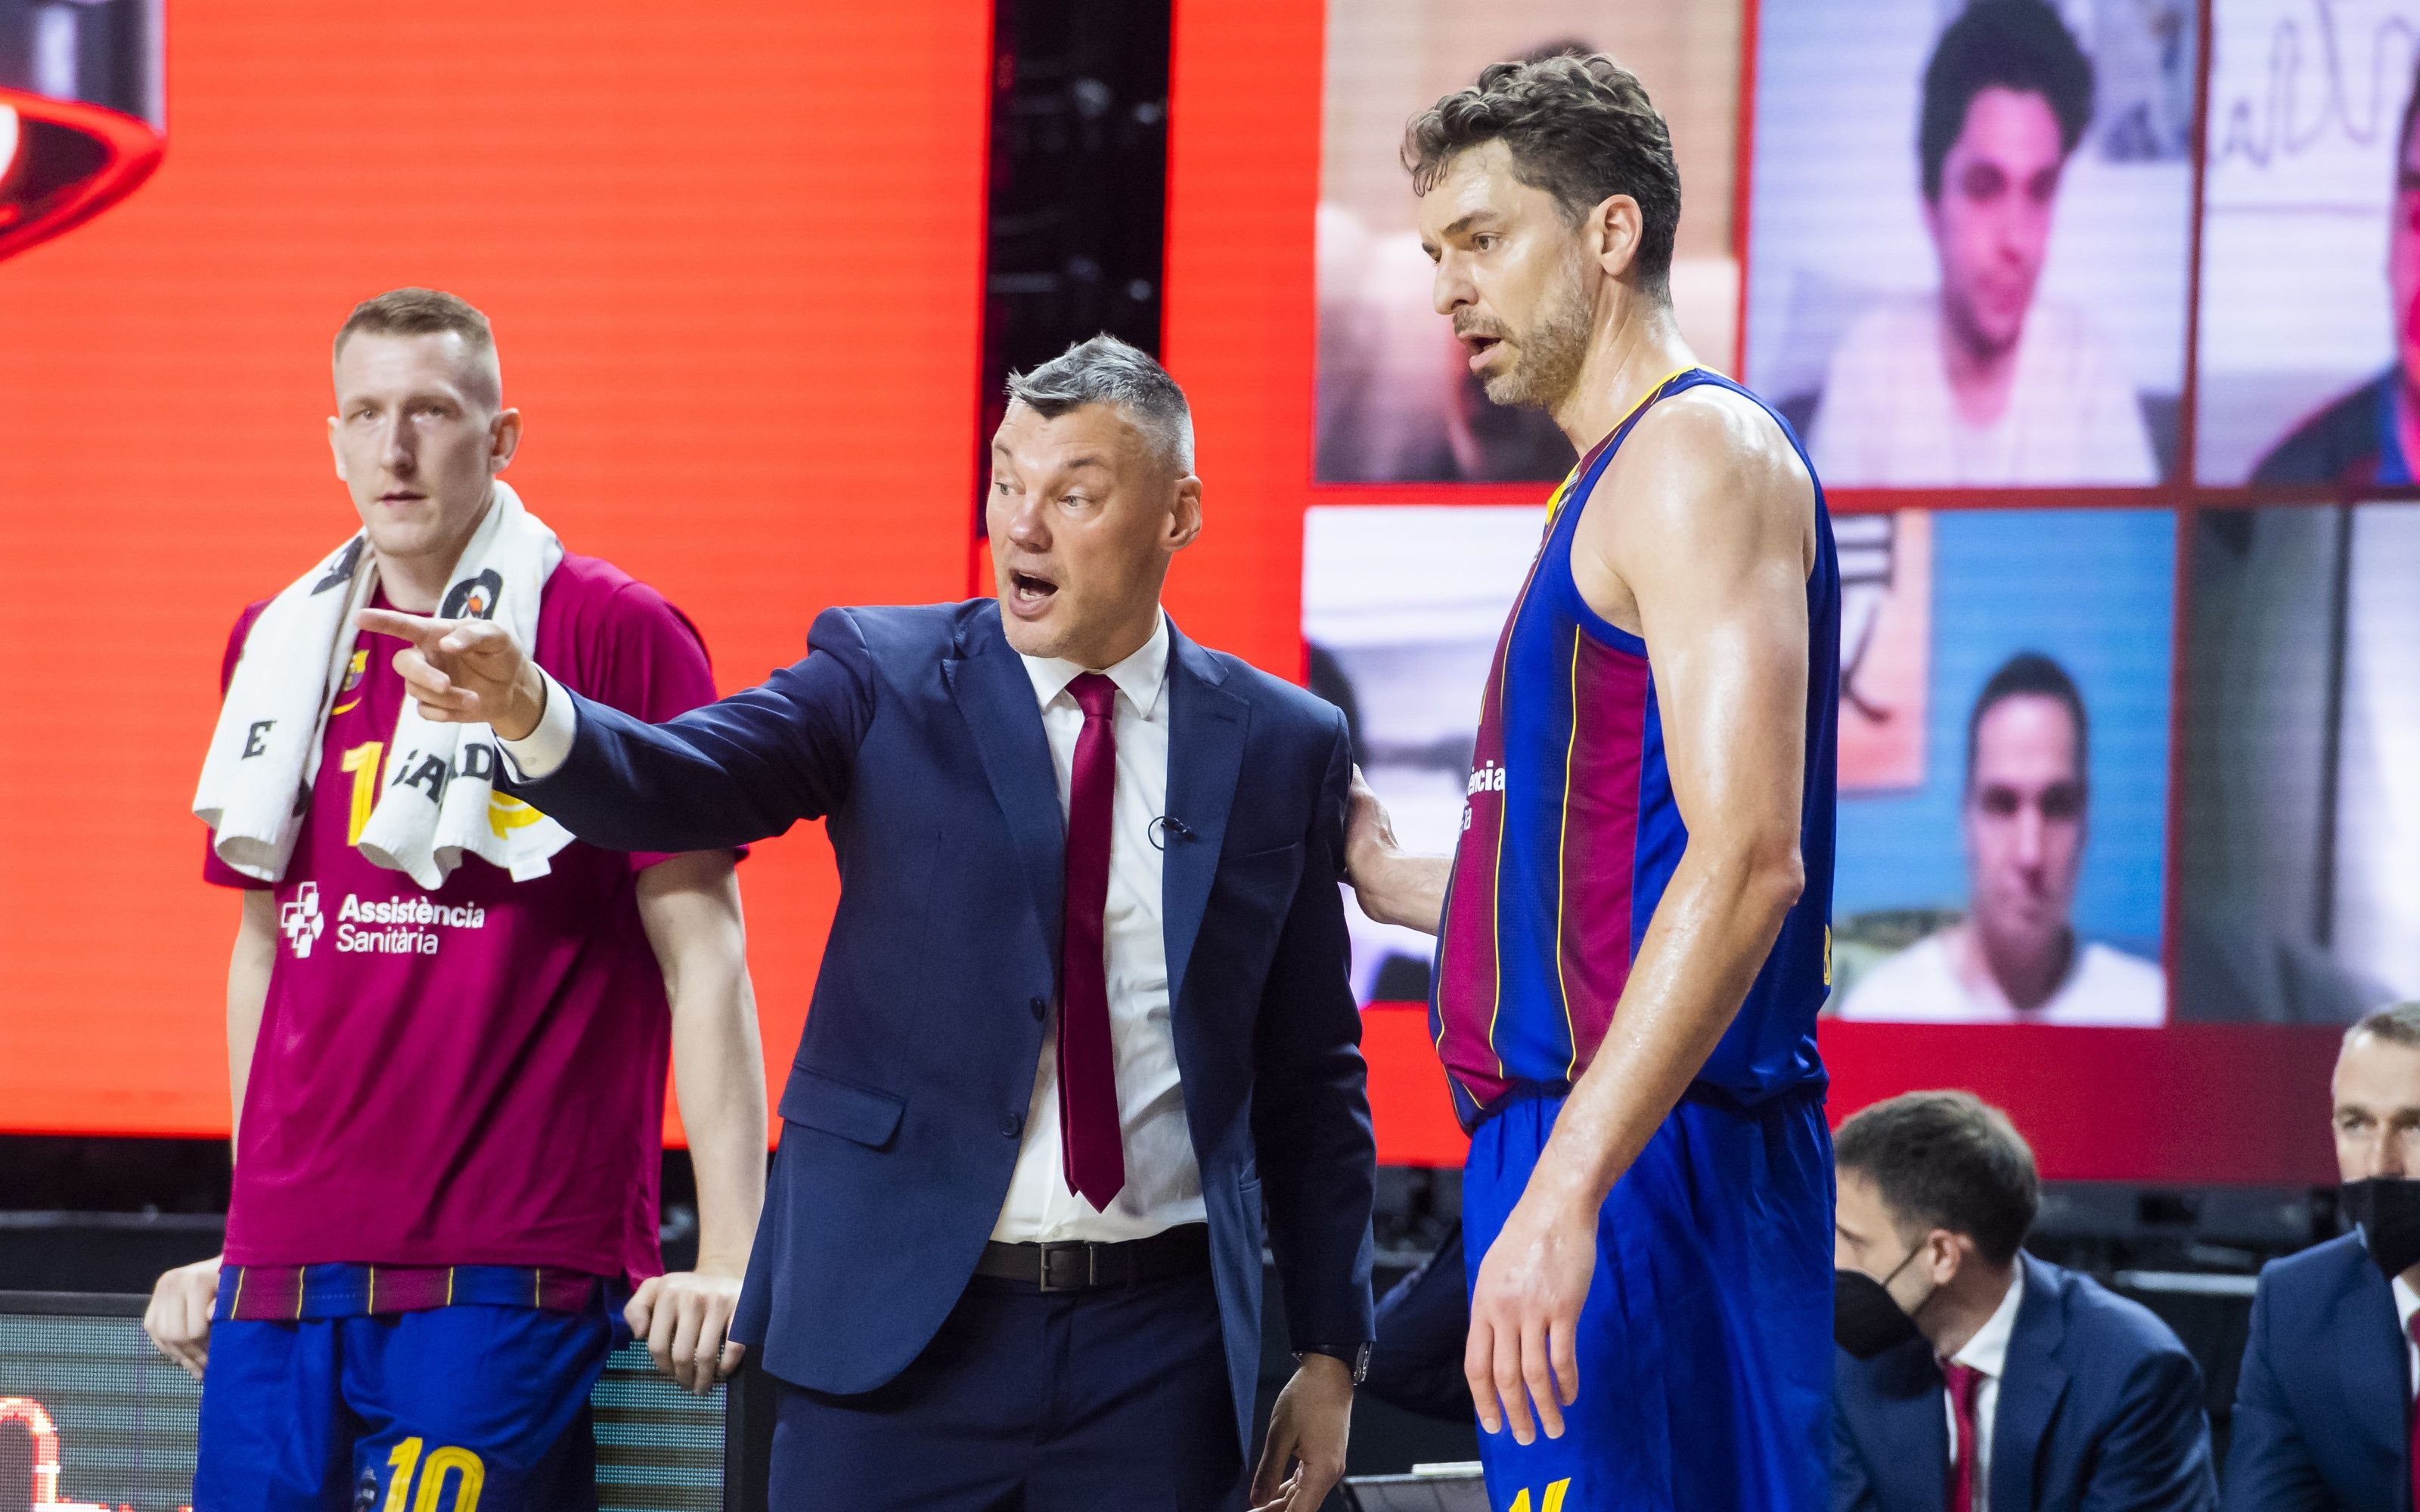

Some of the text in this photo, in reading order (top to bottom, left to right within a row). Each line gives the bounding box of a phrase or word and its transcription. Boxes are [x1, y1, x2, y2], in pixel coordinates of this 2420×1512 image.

[338, 893, 485, 928] Assistència
[337, 923, 439, 955] Sanitària
[383, 1436, 485, 1512] 10
